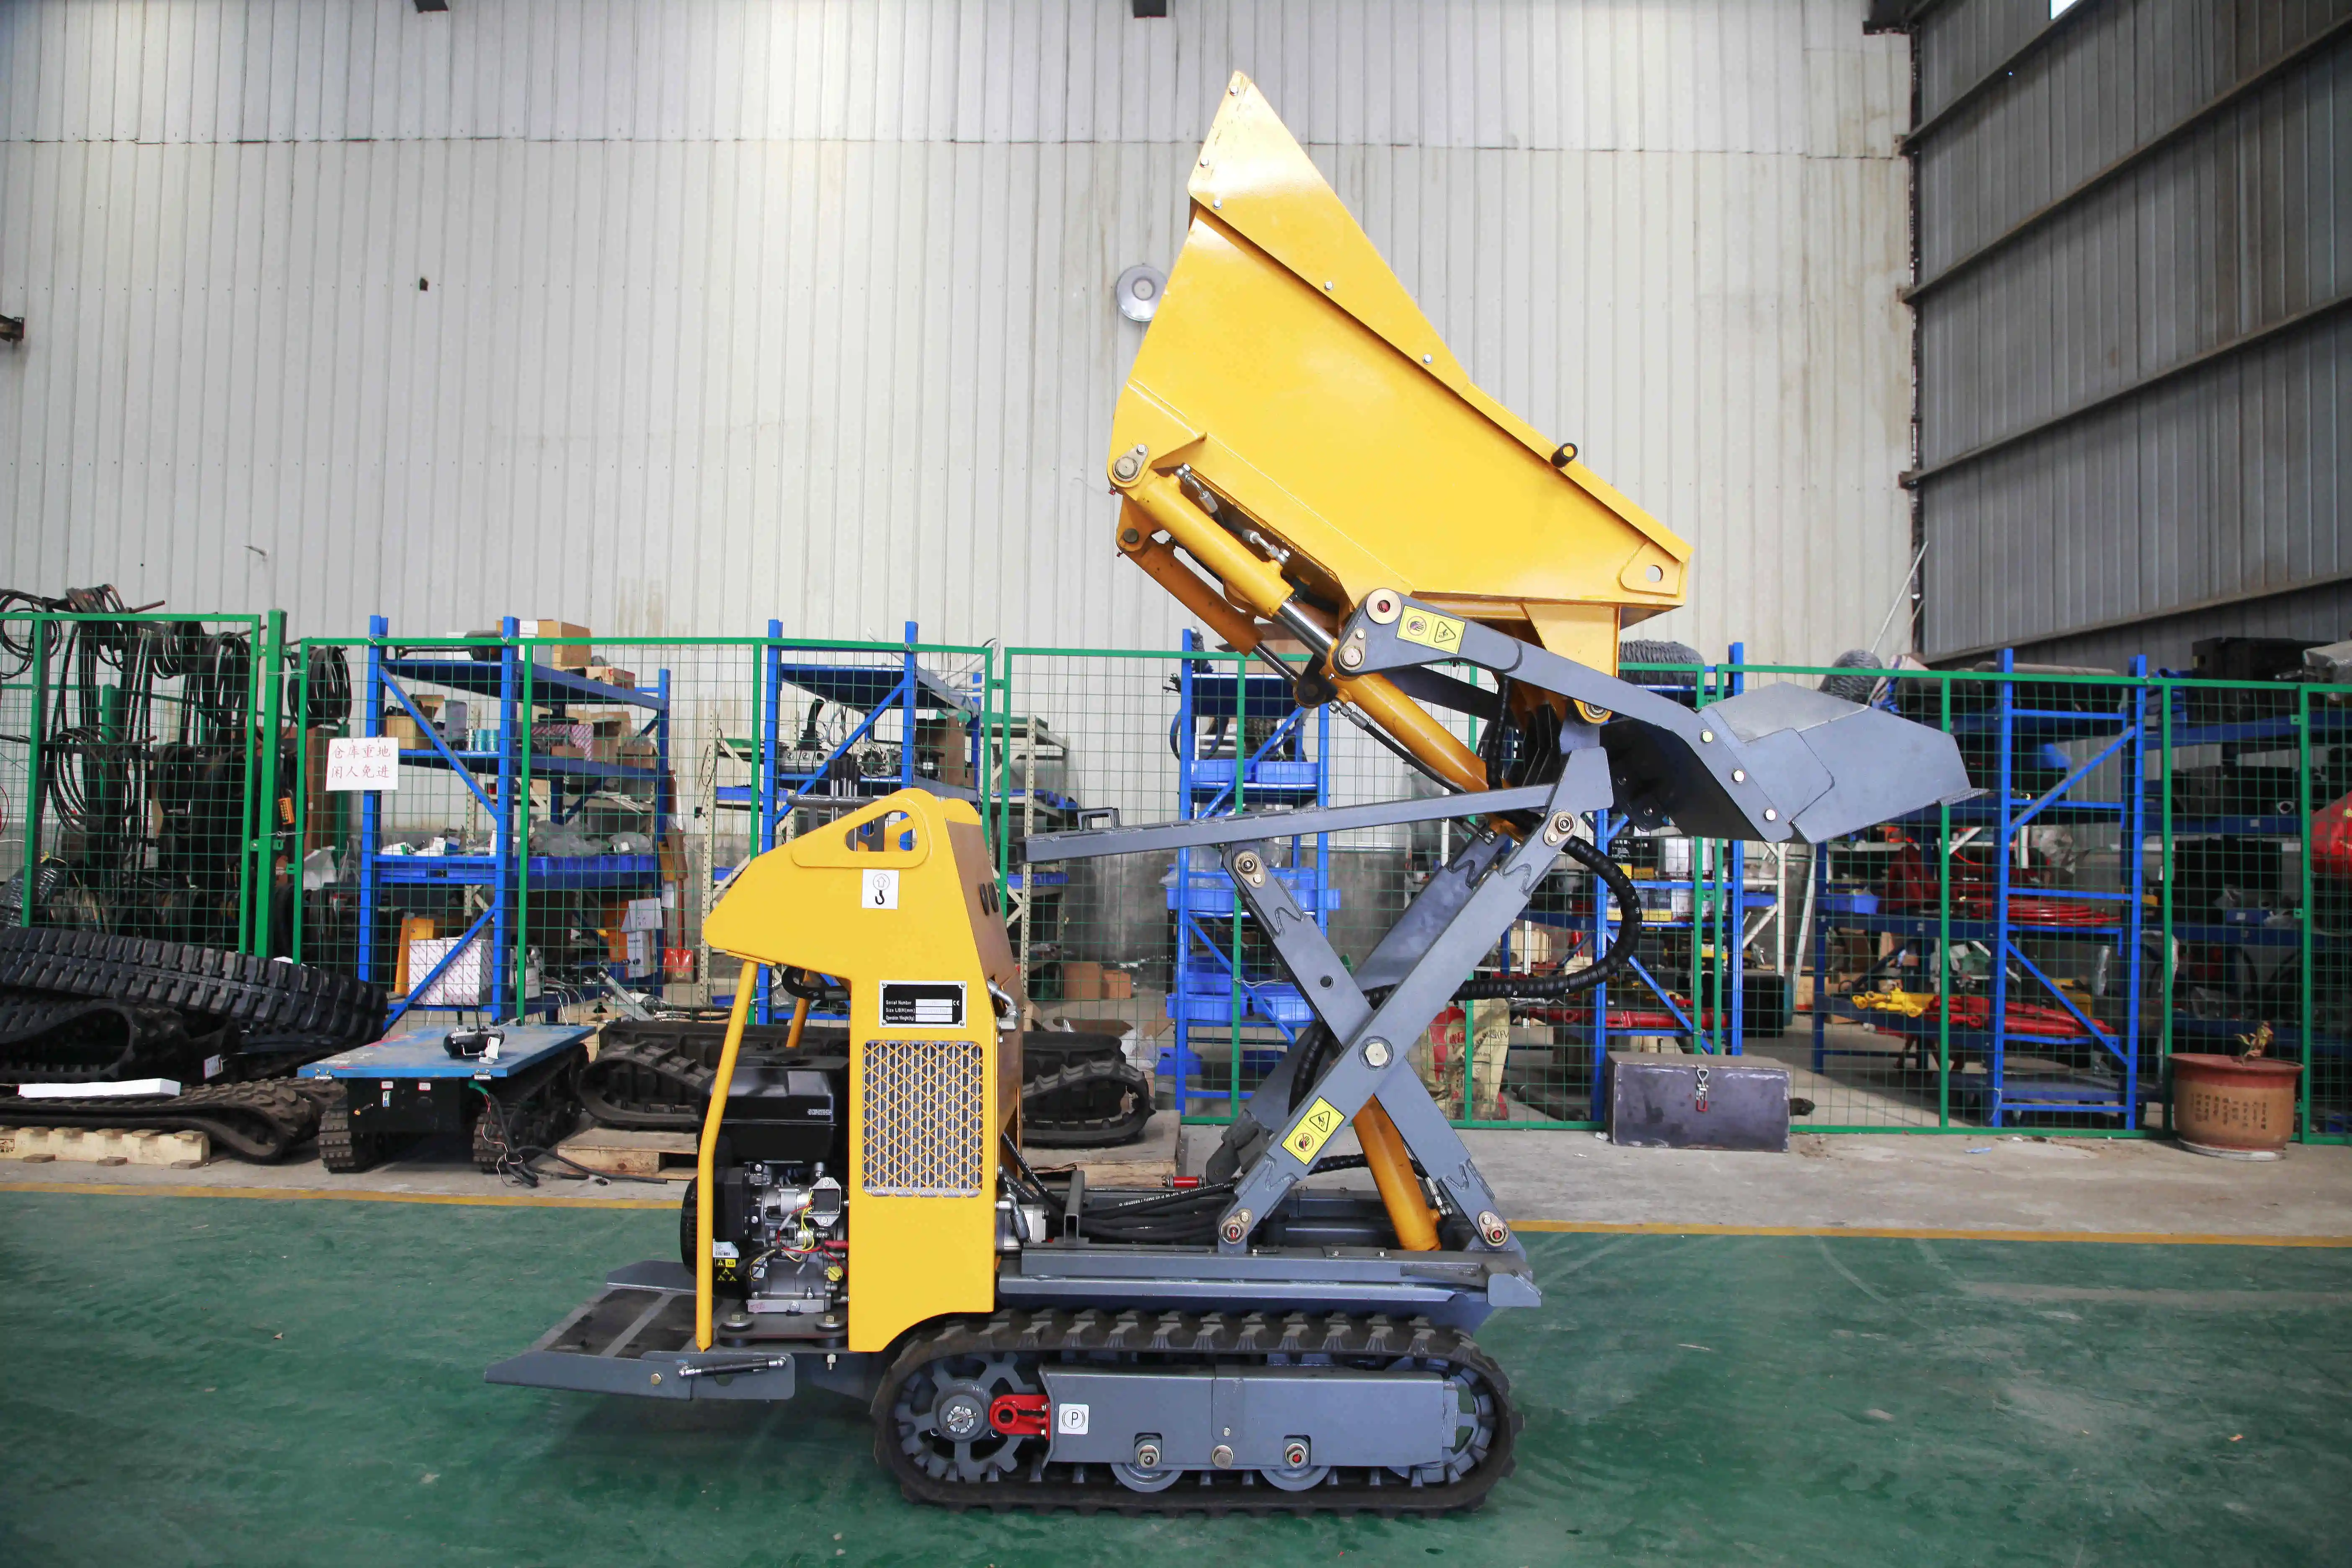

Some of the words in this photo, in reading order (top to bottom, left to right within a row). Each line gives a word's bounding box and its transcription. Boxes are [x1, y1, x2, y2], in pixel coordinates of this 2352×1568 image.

[332, 745, 391, 759] 仓库重地
[331, 764, 390, 779] 闲人免进
[1071, 1412, 1078, 1426] P
